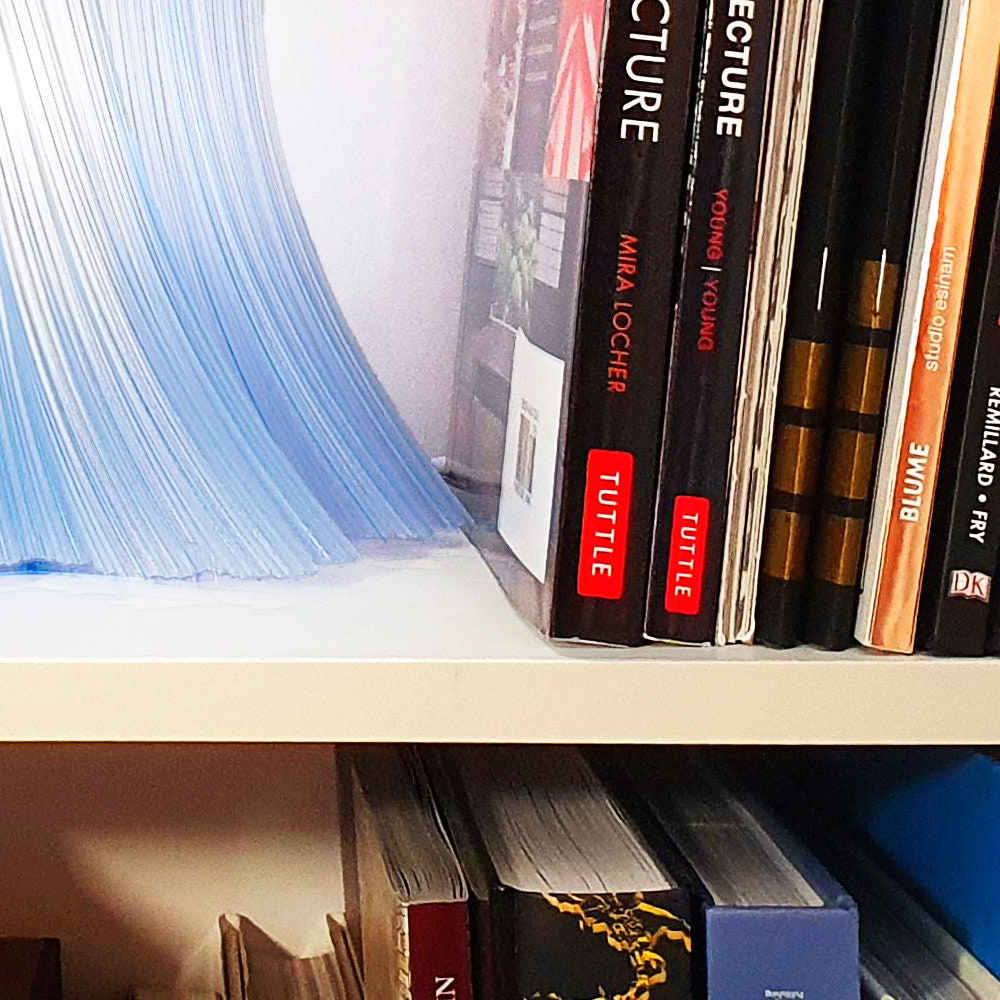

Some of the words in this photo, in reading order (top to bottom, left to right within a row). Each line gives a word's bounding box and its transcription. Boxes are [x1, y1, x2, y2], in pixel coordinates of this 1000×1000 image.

[706, 188, 729, 260] YOUNG
[616, 234, 639, 292] MIRA
[934, 245, 957, 311] esinam
[607, 302, 633, 394] LOCHER
[698, 279, 719, 352] YOUNG
[925, 316, 946, 372] studio
[977, 386, 1000, 487] REMILLARD
[900, 442, 930, 523] BLUME
[591, 471, 620, 577] TUTTLE
[674, 513, 699, 598] TUTTLE
[968, 509, 988, 544] FRY
[954, 571, 985, 597] DK
